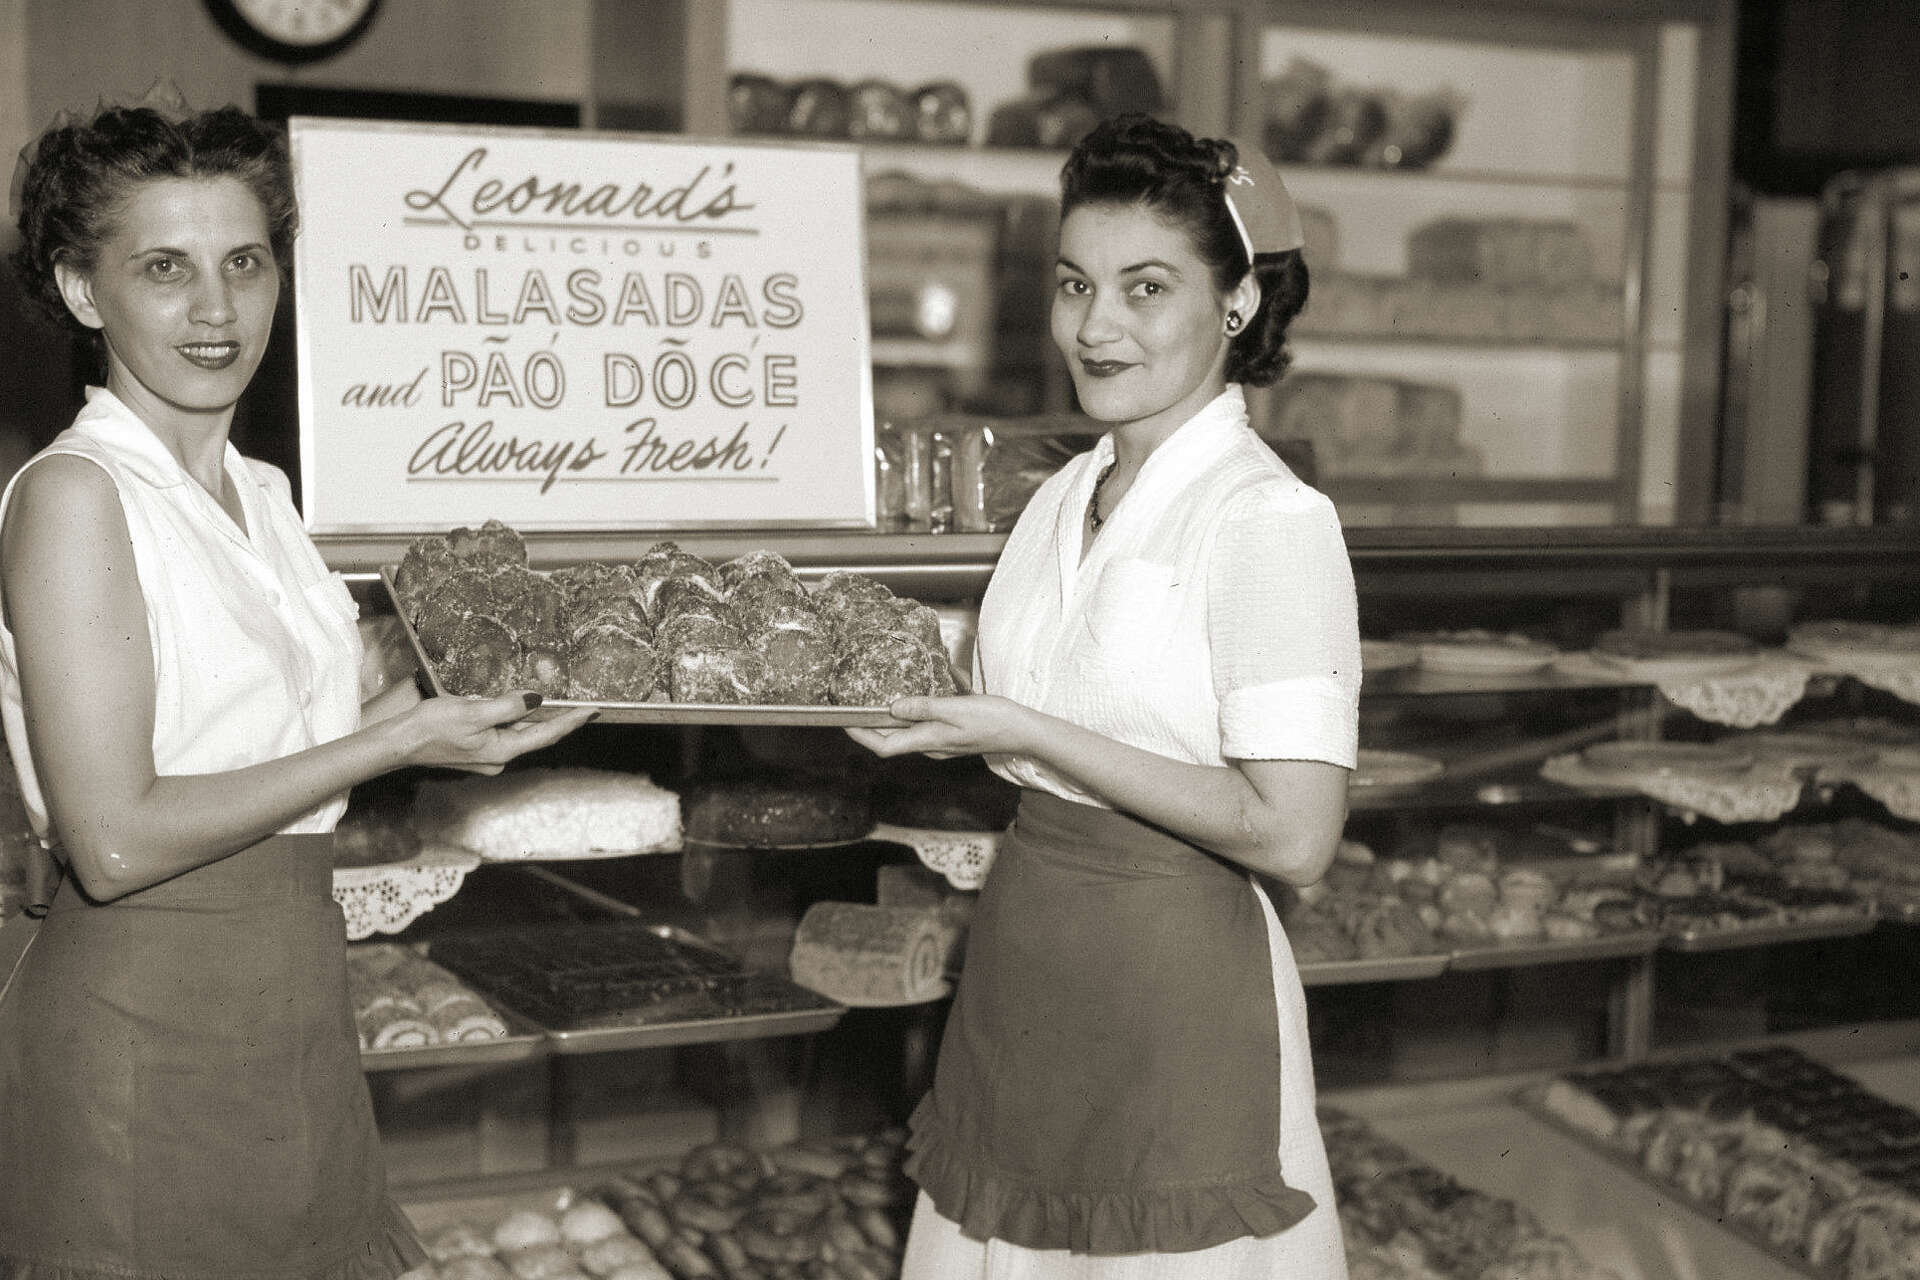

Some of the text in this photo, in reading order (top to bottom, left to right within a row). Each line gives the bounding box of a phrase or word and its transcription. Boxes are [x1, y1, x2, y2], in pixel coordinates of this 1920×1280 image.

[404, 148, 756, 230] Leonard's
[464, 233, 714, 259] DELICIOUS
[349, 264, 805, 328] MALASADAS
[341, 366, 430, 408] and
[407, 416, 787, 495] Always Fresh!
